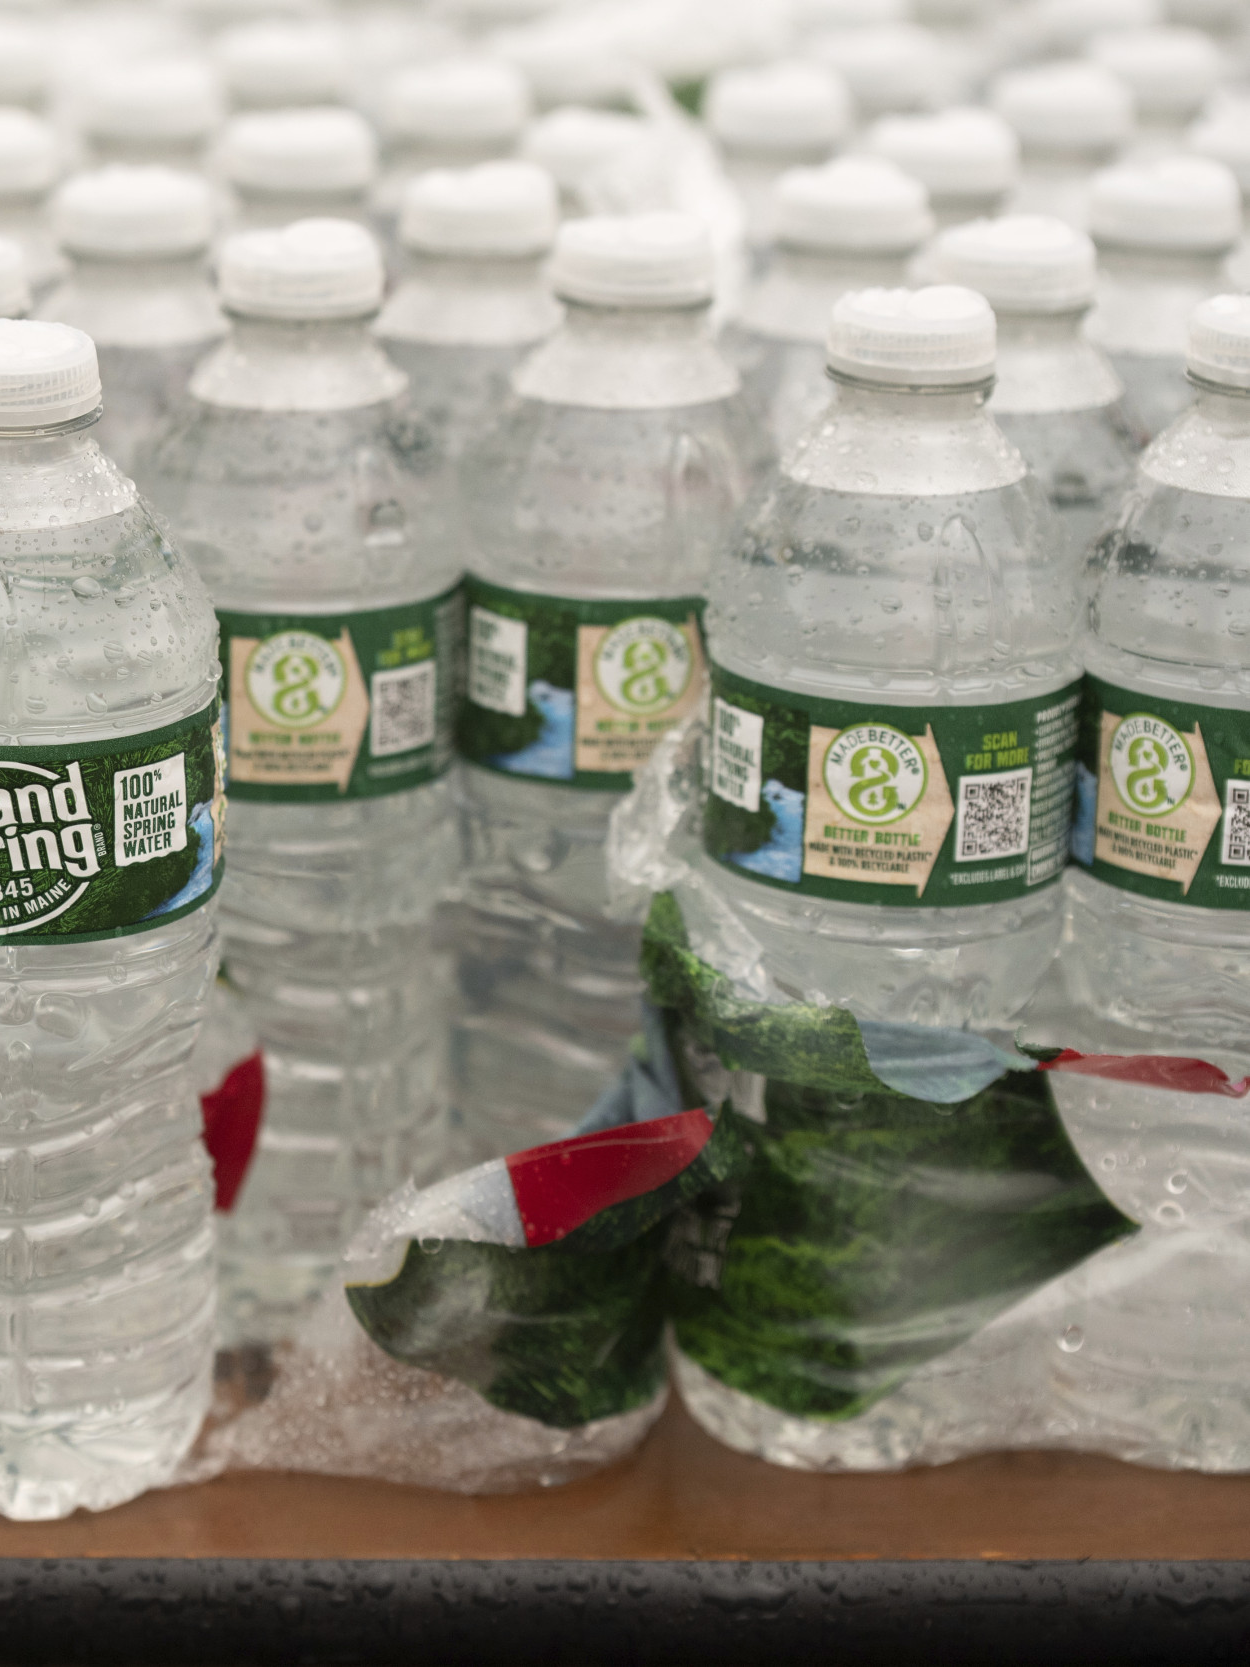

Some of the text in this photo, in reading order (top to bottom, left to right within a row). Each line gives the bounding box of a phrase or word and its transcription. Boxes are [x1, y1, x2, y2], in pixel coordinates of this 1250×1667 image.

[982, 731, 1018, 751] SCAN
[965, 747, 1030, 770] FOR MORE
[120, 769, 162, 801] 100%
[123, 790, 183, 821] NATURAL
[123, 812, 176, 840] SPRING
[824, 825, 921, 847] BETTER BOTTLE
[1108, 811, 1187, 842] BETTER BOTTLE
[123, 831, 173, 859] WATER
[3, 902, 20, 921] IN
[26, 877, 72, 915] MAINE
